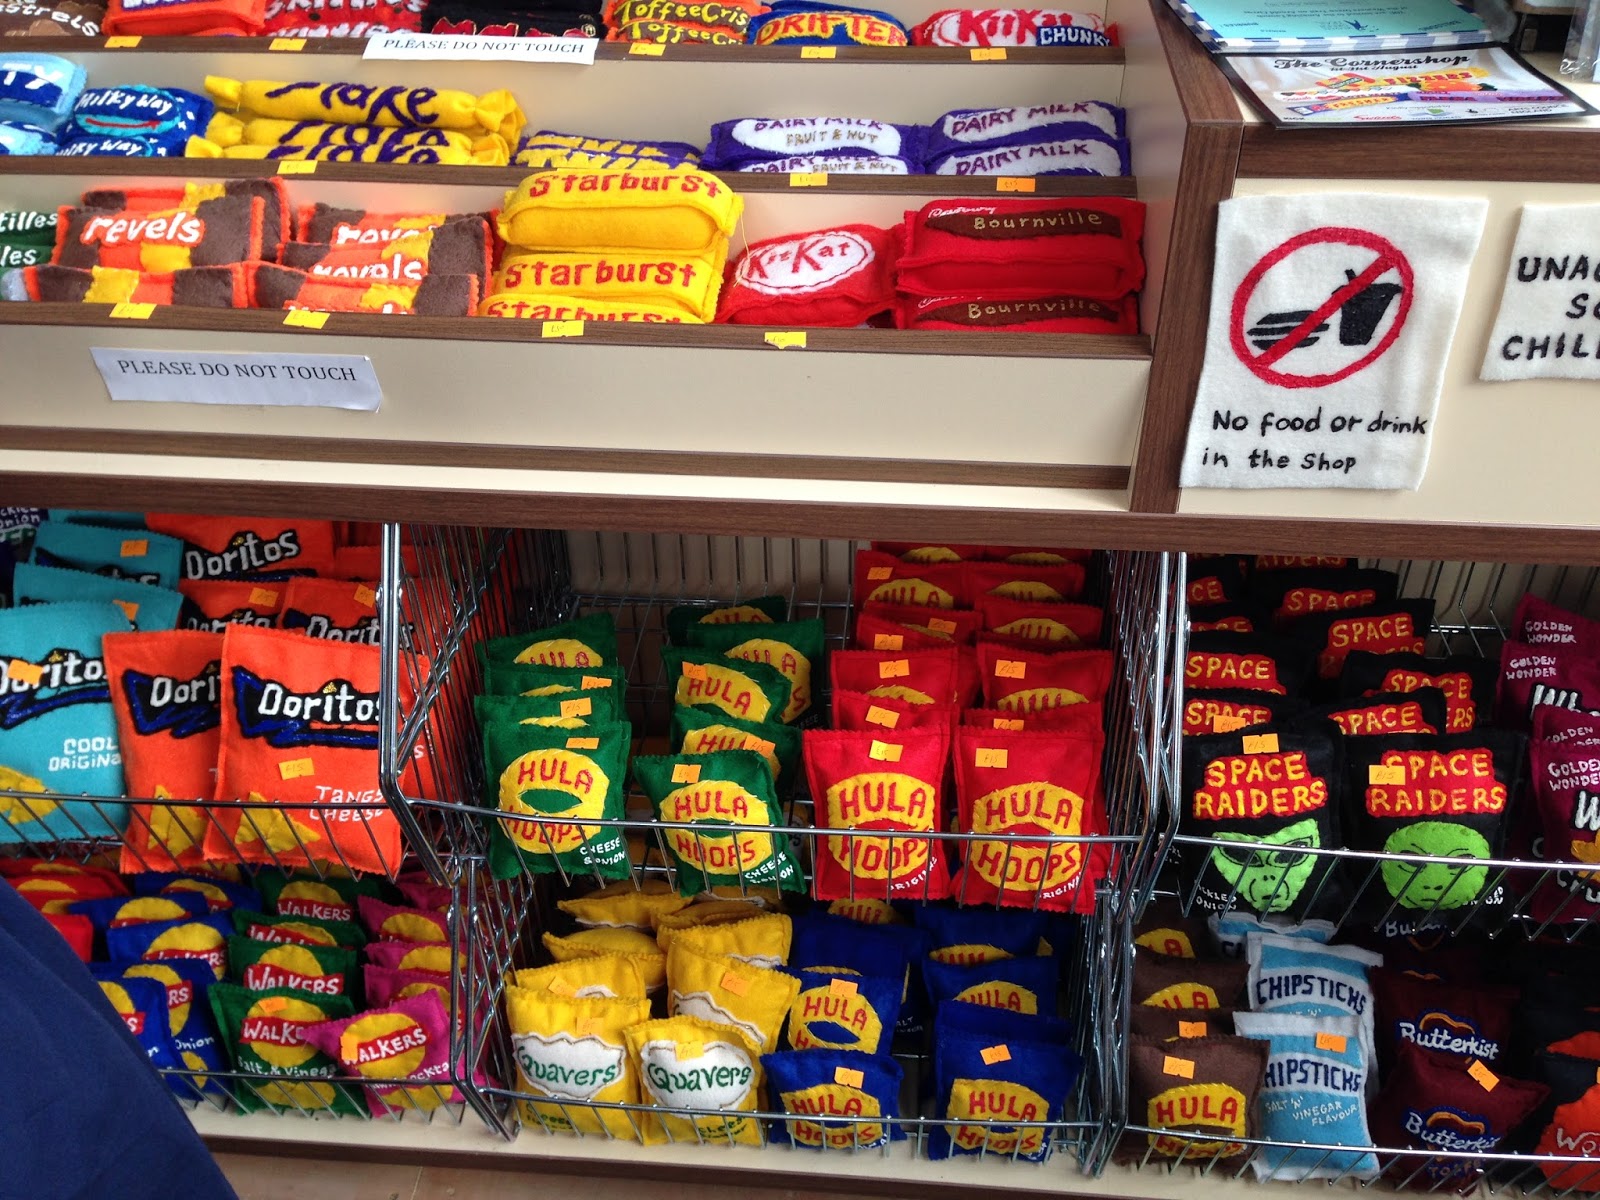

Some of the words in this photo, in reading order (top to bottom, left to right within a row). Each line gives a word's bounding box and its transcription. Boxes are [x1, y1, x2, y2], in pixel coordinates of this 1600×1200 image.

[0, 2, 100, 37] strels
[384, 39, 450, 49] PLEASE
[453, 41, 478, 50] DO
[483, 41, 520, 51] NOT
[524, 43, 585, 54] TOUCH
[1040, 27, 1110, 46] CHUNKY
[1273, 59, 1322, 70] The
[1325, 55, 1470, 68] Cornershop
[137, 94, 173, 115] Way
[754, 118, 815, 130] DAIRY
[951, 108, 1017, 137] DAIRY
[1027, 102, 1090, 119] MILK
[786, 129, 828, 146] FRUIT
[847, 130, 878, 144] NUT
[955, 148, 1022, 176] DAIRY
[1029, 143, 1092, 158] MILK
[529, 173, 723, 199] Starburst
[84, 211, 201, 244] revels
[973, 211, 1103, 231] Bournville
[505, 260, 698, 289] Starburst
[967, 299, 1100, 320] Bournville
[1502, 332, 1600, 361] CHIL
[118, 360, 197, 377] PLEASE
[200, 362, 230, 378] DO
[237, 363, 279, 380] NOT
[283, 365, 358, 382] TOUCH
[1212, 410, 1249, 432] No
[1260, 406, 1322, 437] food
[1331, 413, 1362, 433] or
[1368, 408, 1428, 436] drink
[1201, 447, 1229, 469] in
[1248, 449, 1290, 471] the
[1300, 450, 1357, 475] Shop
[186, 529, 300, 580] Doritos
[1332, 616, 1410, 648] SPACE
[1525, 620, 1573, 633] GOLDEN
[1527, 633, 1577, 644] WONDER
[1185, 655, 1271, 680] SPACE
[1506, 666, 1557, 680] WONDER
[1509, 655, 1557, 669] GOLDEN
[686, 676, 752, 715] HULA
[63, 736, 119, 755] COOL
[517, 757, 594, 795] HULA
[1206, 753, 1306, 788] SPACE
[674, 790, 750, 821] HULA
[838, 780, 927, 822] HULA
[984, 789, 1073, 830] HULA
[1195, 780, 1326, 817] RAIDERS
[1370, 786, 1507, 814] RAIDERS
[979, 841, 1077, 884] HOOPS
[277, 900, 352, 921] WALKERS
[803, 995, 868, 1032] HULA
[343, 1026, 428, 1066] ALKERS
[1398, 1021, 1500, 1060] Butterkist
[518, 1045, 617, 1087] Quavers
[647, 1062, 753, 1093] Quavers
[1262, 1058, 1363, 1093] HIPSTICKS
[789, 1093, 863, 1116] HULA
[968, 1090, 1038, 1121] HULA
[1156, 1095, 1239, 1124] HULA
[1264, 1099, 1288, 1114] SALT
[1292, 1100, 1343, 1120] VINEGAR
[1311, 1103, 1358, 1127] FLAVOUR
